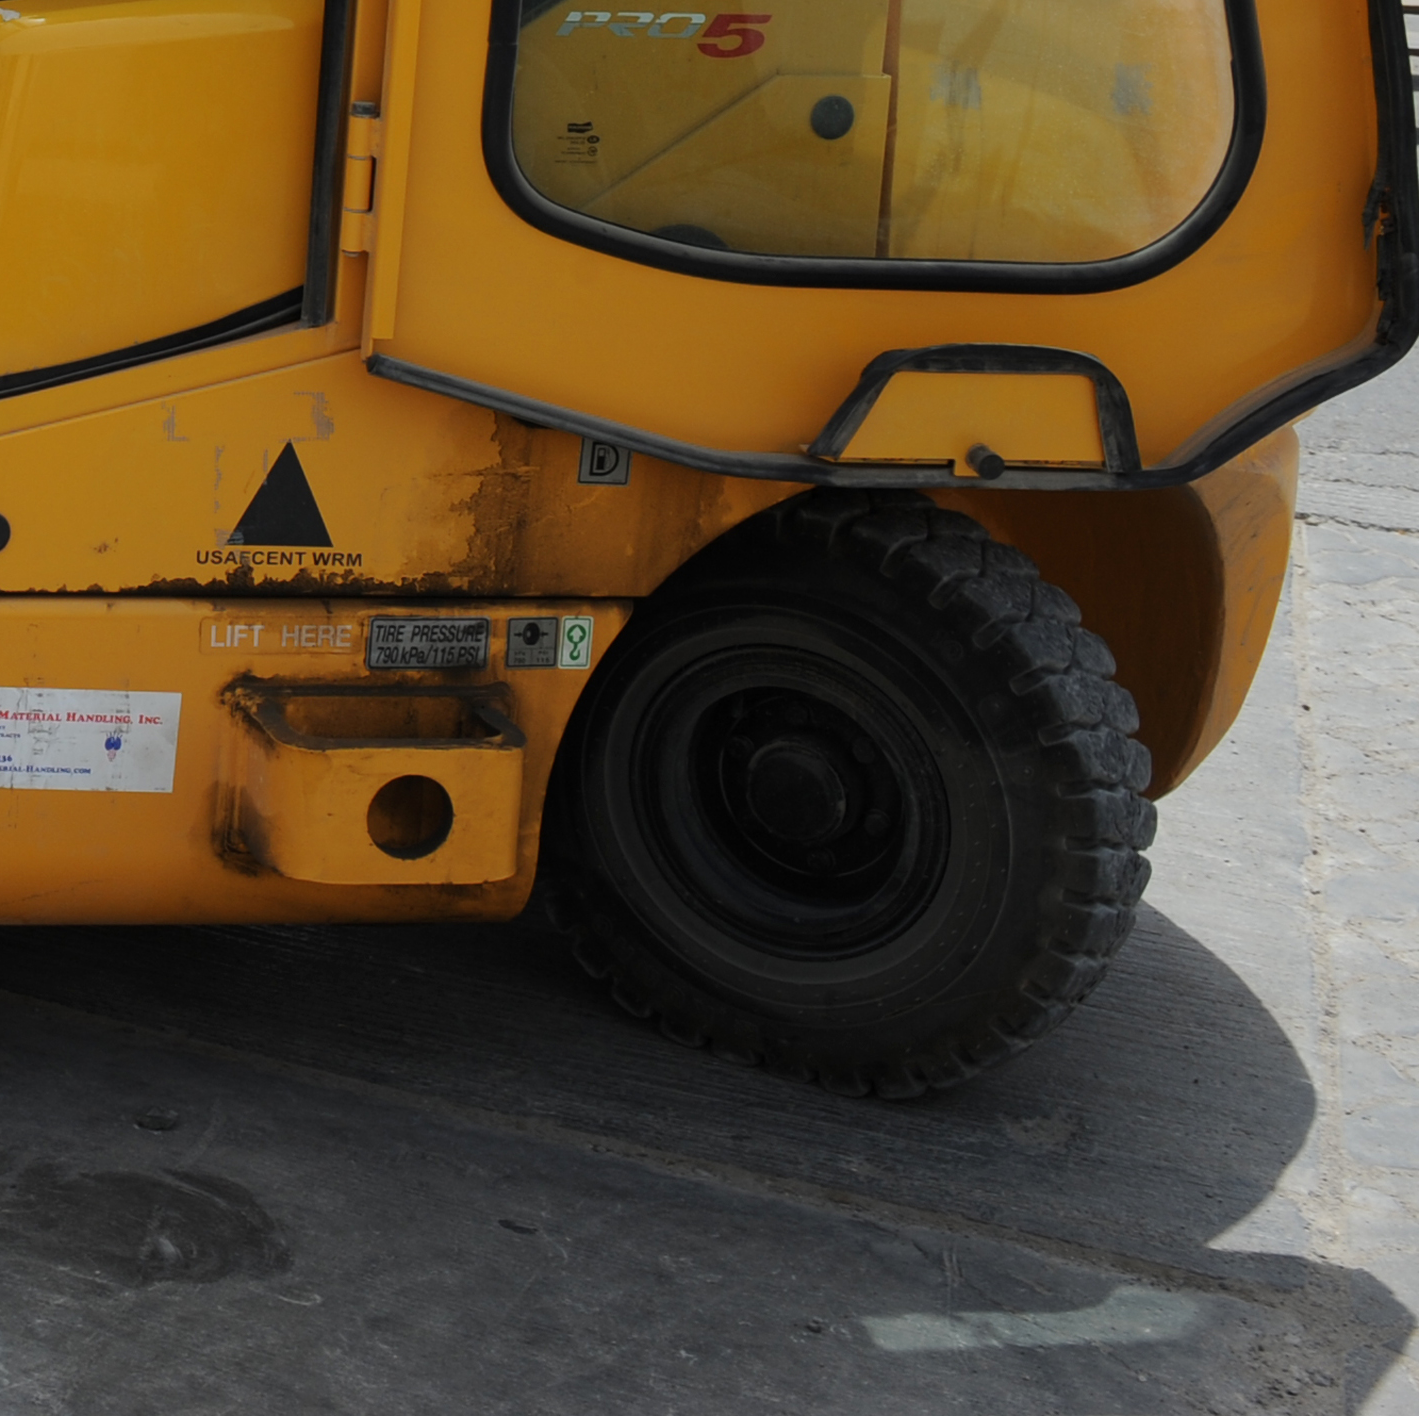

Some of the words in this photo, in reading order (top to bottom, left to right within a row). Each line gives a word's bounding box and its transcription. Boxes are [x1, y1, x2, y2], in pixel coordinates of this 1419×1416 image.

[313, 551, 363, 568] WRM
[210, 624, 265, 649] LIFT
[280, 624, 354, 649] HERE
[375, 624, 407, 643] TIRE
[410, 623, 486, 643] PRESSURE
[375, 646, 399, 665] 790
[400, 643, 456, 665] kPa/115
[457, 645, 480, 665] PSI
